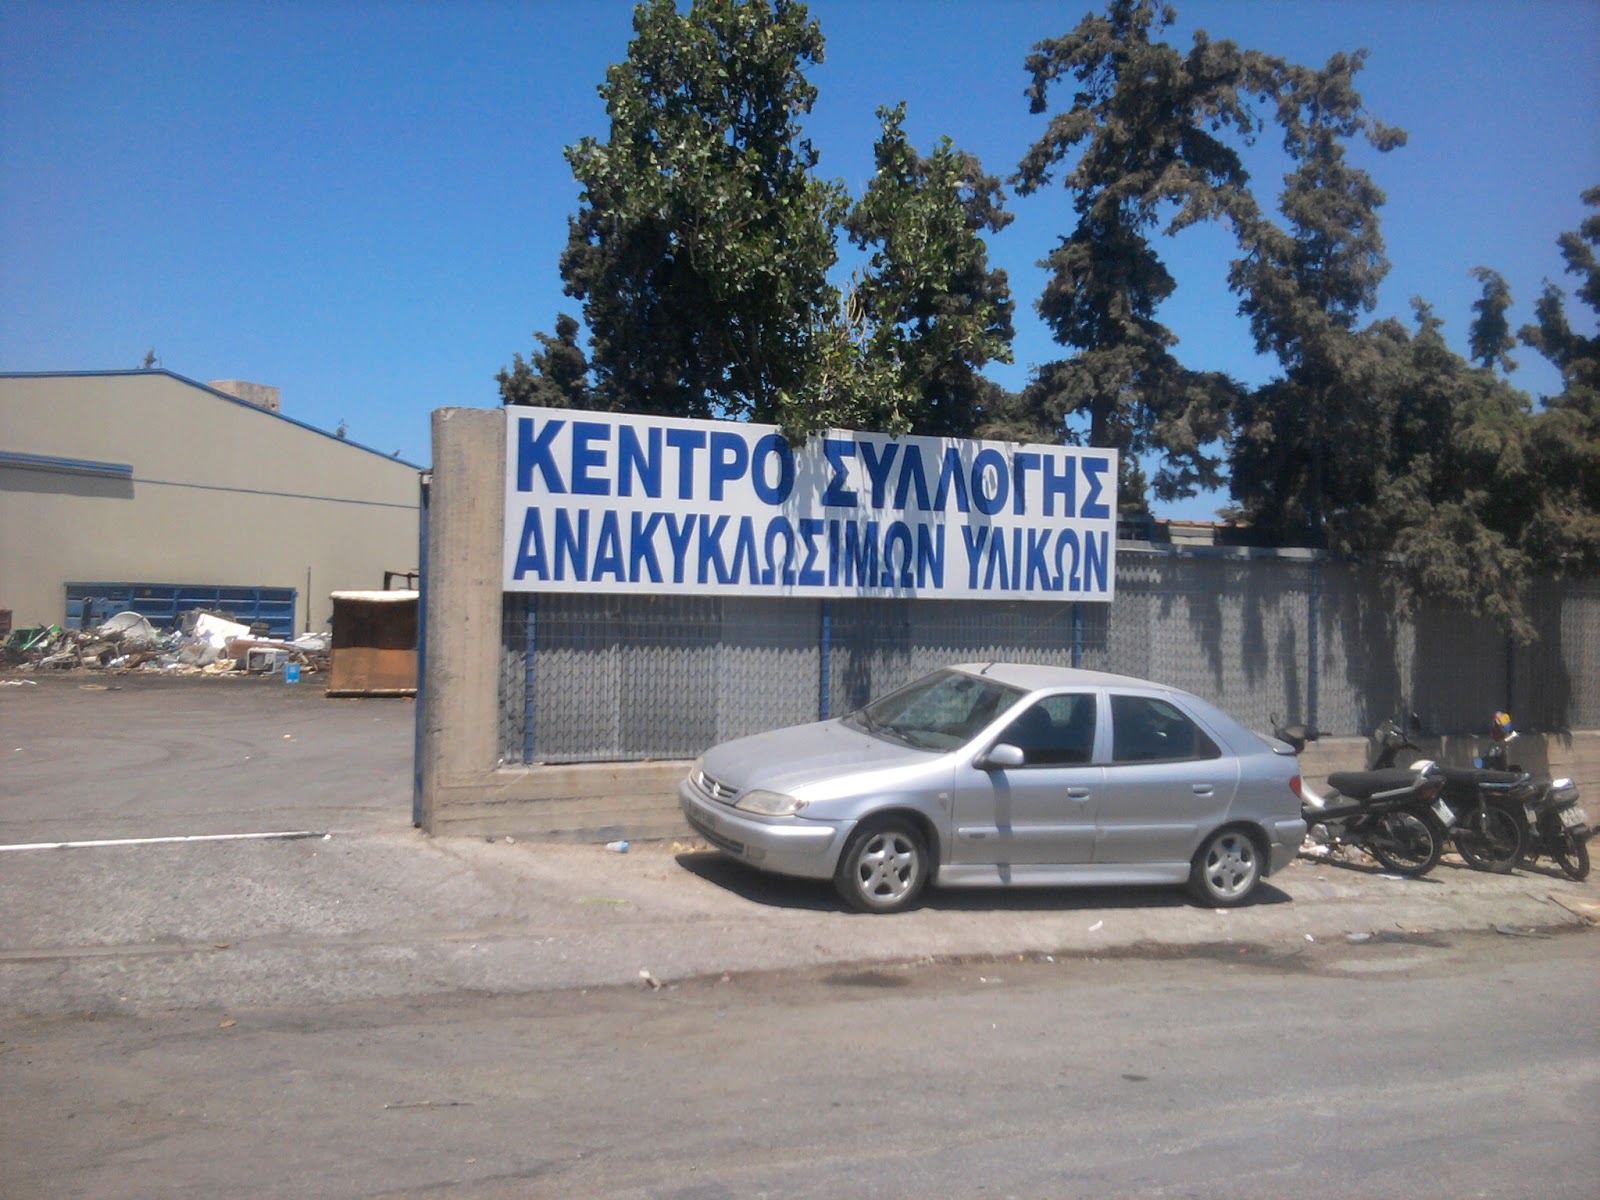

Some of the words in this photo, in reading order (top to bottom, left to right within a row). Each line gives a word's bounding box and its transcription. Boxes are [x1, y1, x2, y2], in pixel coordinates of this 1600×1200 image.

[517, 417, 795, 506] ΚΕΝΤΡΟ
[821, 438, 1110, 519] ΣΥΛΛΟΓΗΣ
[513, 506, 946, 589] ΑΝΑΚΥΚΛΩΣΙΜΩΝ
[961, 524, 1109, 592] ΥΛΙΚΩΝ
